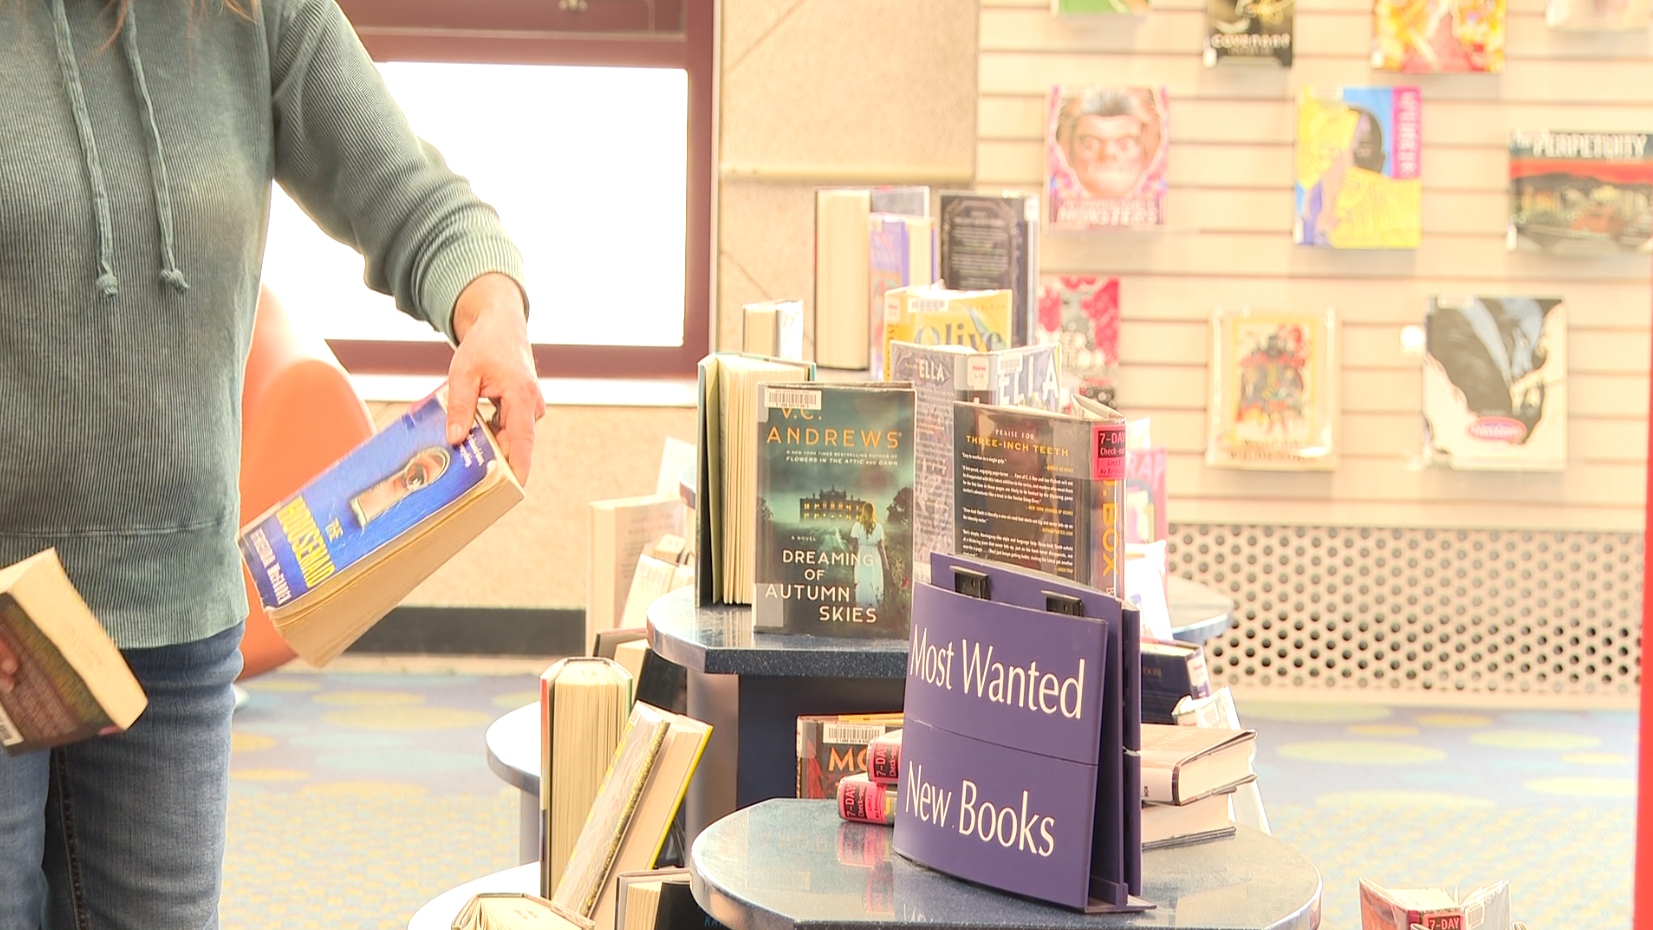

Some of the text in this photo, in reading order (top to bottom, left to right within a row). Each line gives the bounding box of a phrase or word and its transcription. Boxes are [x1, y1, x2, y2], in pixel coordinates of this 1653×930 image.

[918, 358, 945, 382] ELLA
[998, 352, 1059, 405] ELLA
[996, 428, 1034, 440] PRAISE FOR
[966, 435, 1070, 457] THREE-INCH TEETH
[276, 495, 336, 588] HOUSEMAID
[325, 518, 344, 542] THE
[782, 550, 874, 567] DREAMING
[804, 568, 825, 581] OF
[765, 584, 850, 602] AUTUMN
[819, 606, 877, 623] SKIES
[910, 624, 1086, 720] Most Wanted
[846, 784, 856, 817] 7-DAY
[905, 760, 1056, 858] New Books
[1430, 917, 1460, 930] 7-DAY
